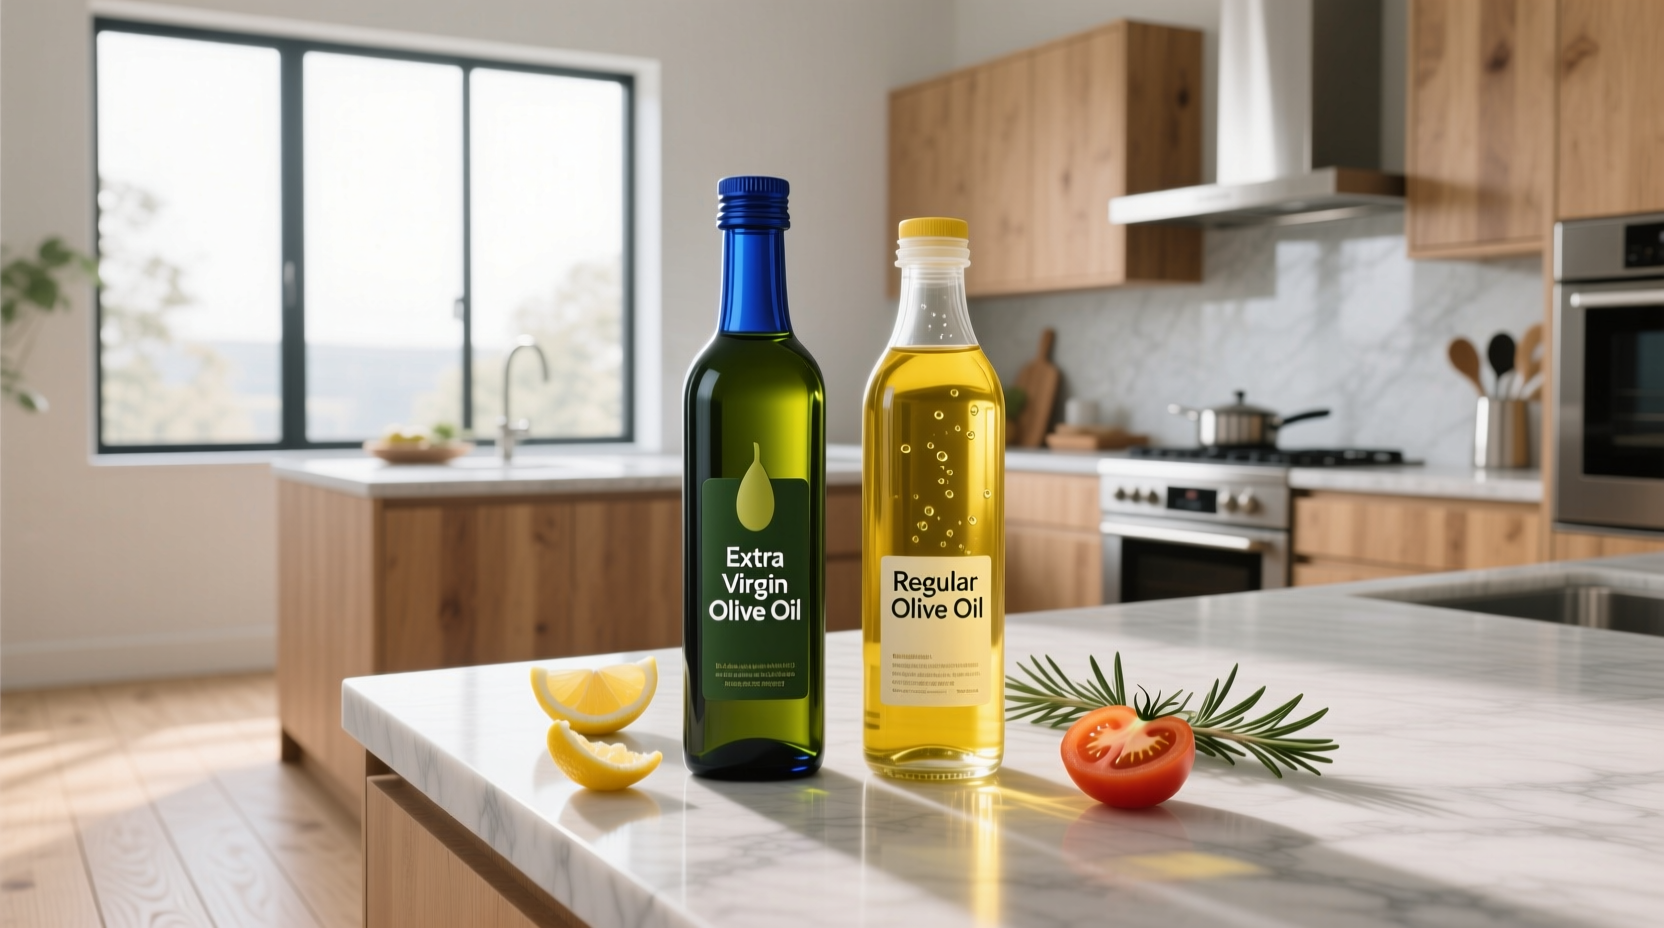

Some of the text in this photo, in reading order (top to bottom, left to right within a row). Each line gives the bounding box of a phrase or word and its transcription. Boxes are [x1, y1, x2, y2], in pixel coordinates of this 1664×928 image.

[726, 546, 784, 568] Extra
[721, 573, 788, 601] Virgin
[893, 570, 978, 598] Regular
[708, 598, 801, 622] Olive Oil
[891, 596, 983, 620] Olive Oil
